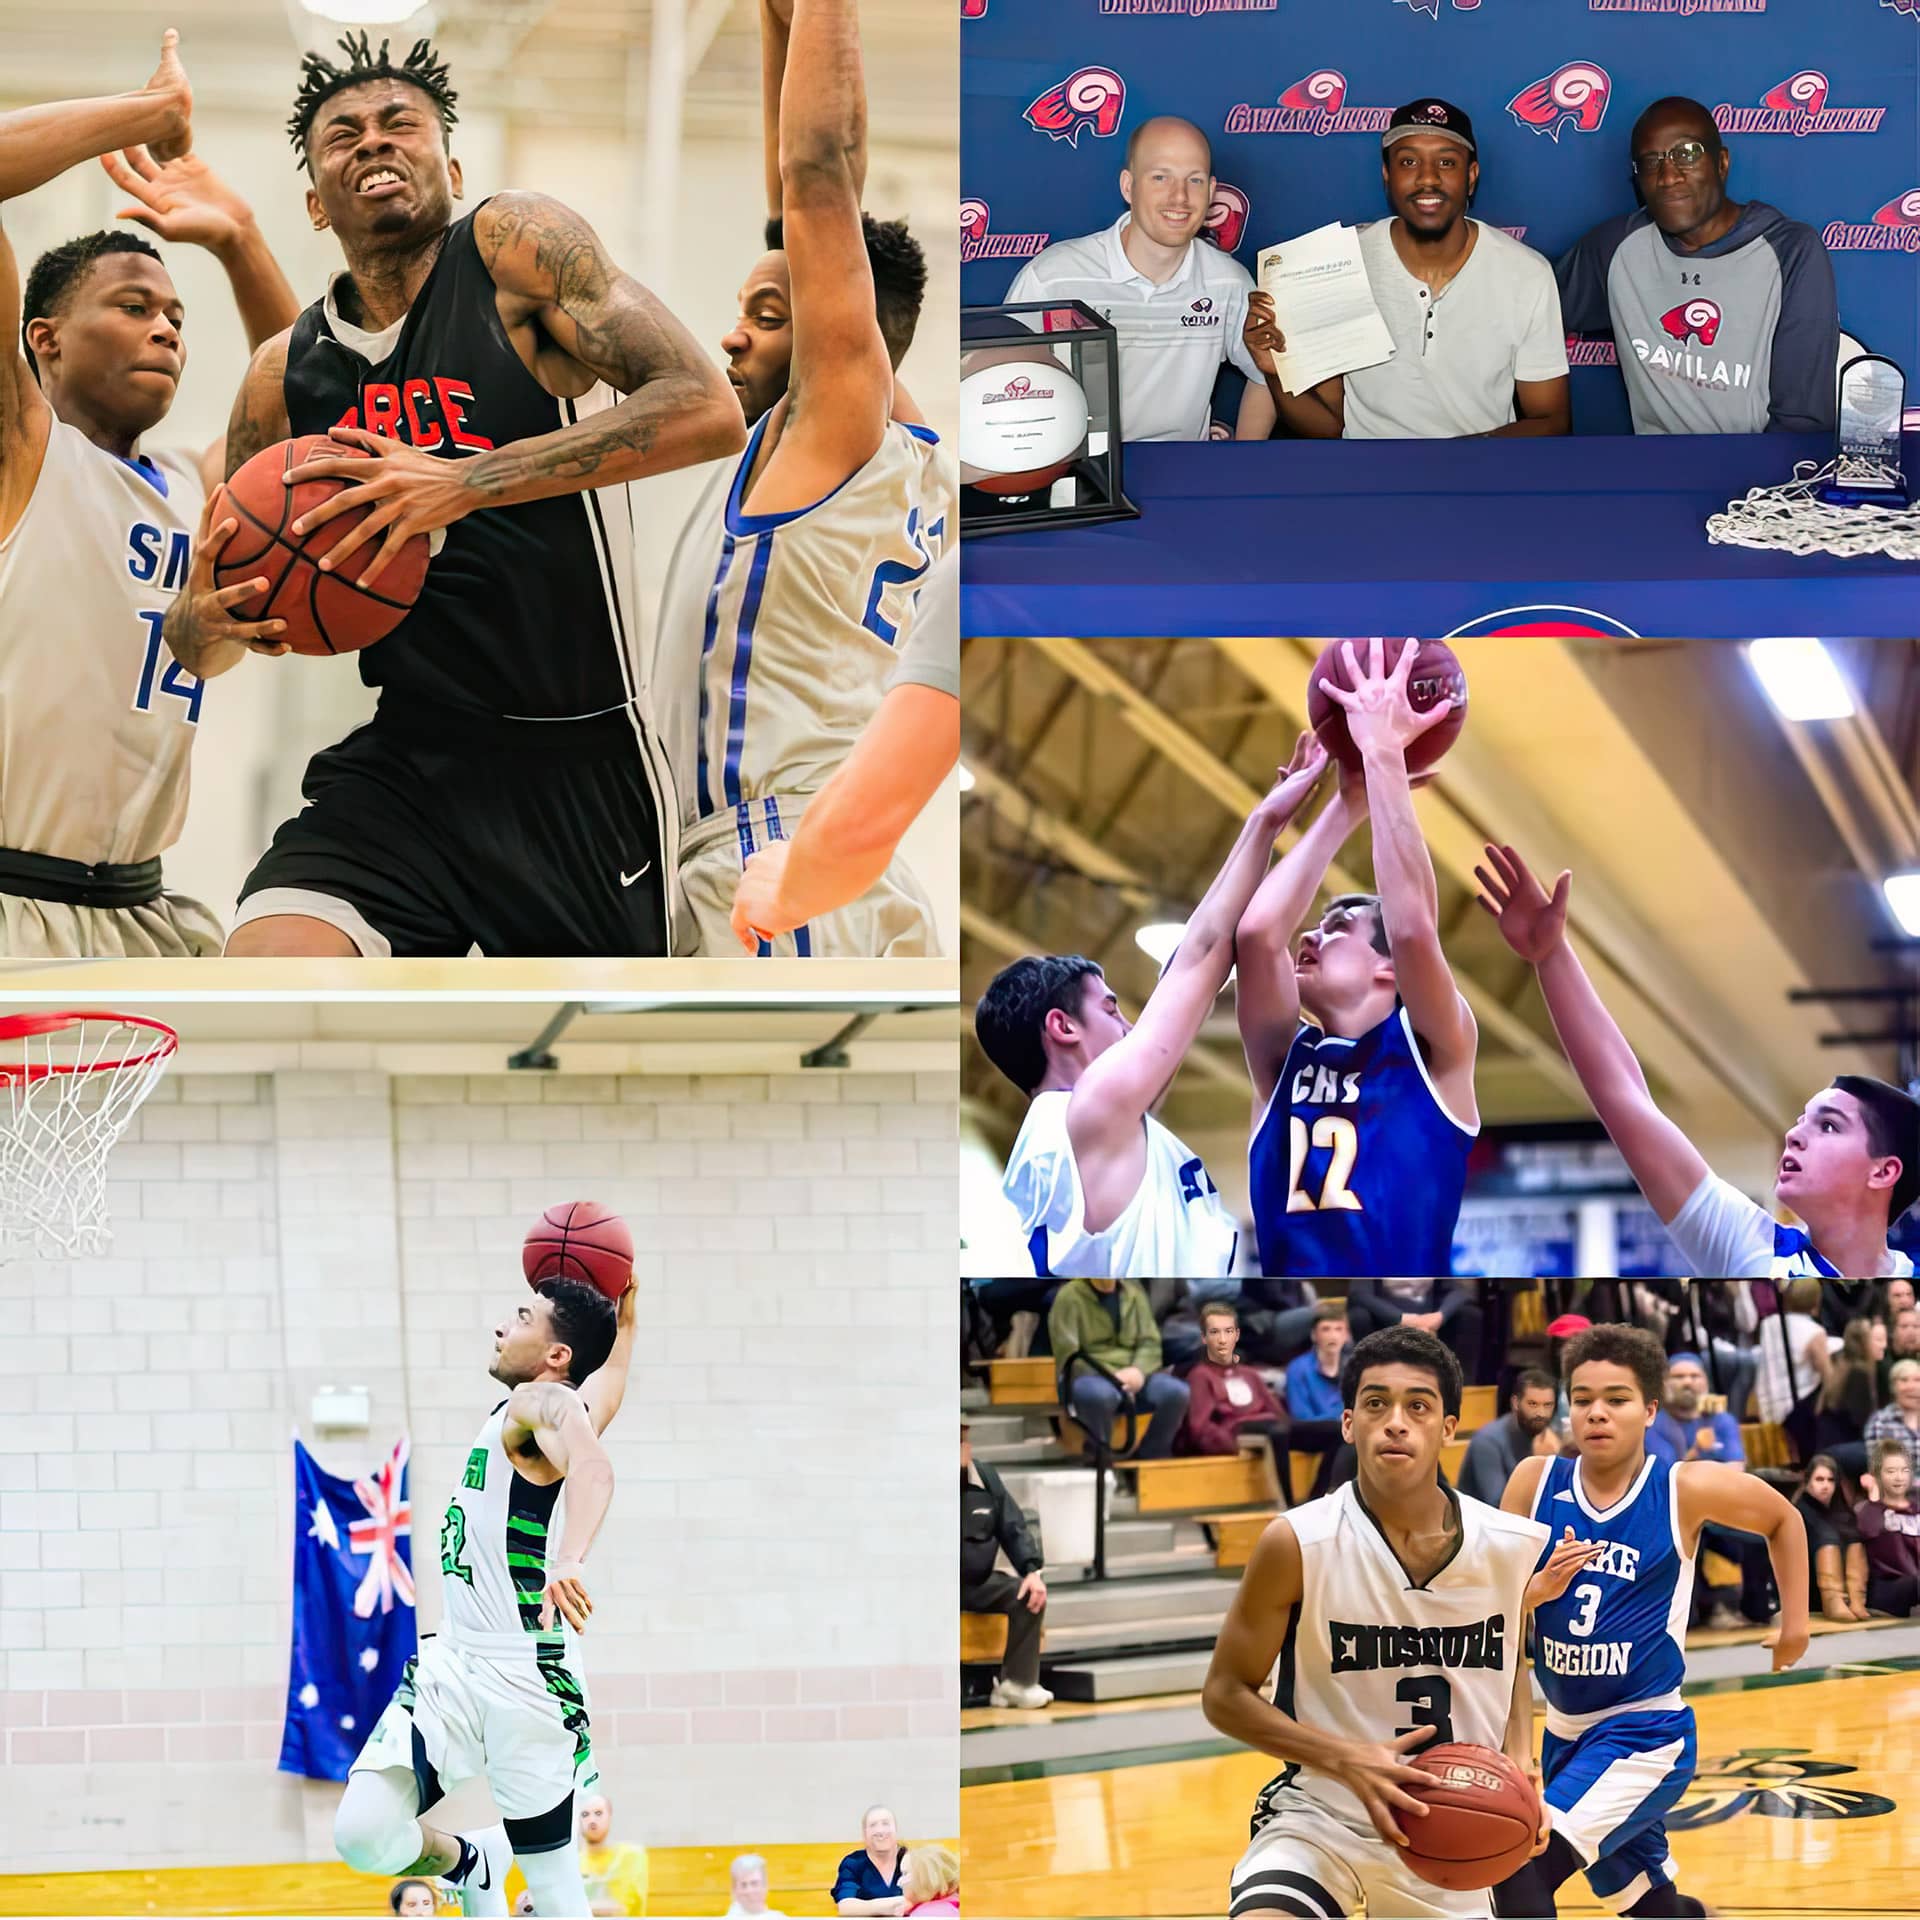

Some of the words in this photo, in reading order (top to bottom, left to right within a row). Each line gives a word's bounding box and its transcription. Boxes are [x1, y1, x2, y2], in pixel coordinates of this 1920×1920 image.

[1631, 338, 1751, 389] GAVILAN
[136, 609, 206, 725] 14
[1555, 1539, 1641, 1582] KE
[1568, 1583, 1602, 1638] 3
[1543, 1636, 1633, 1677] REGION
[1395, 1675, 1454, 1756] 3
